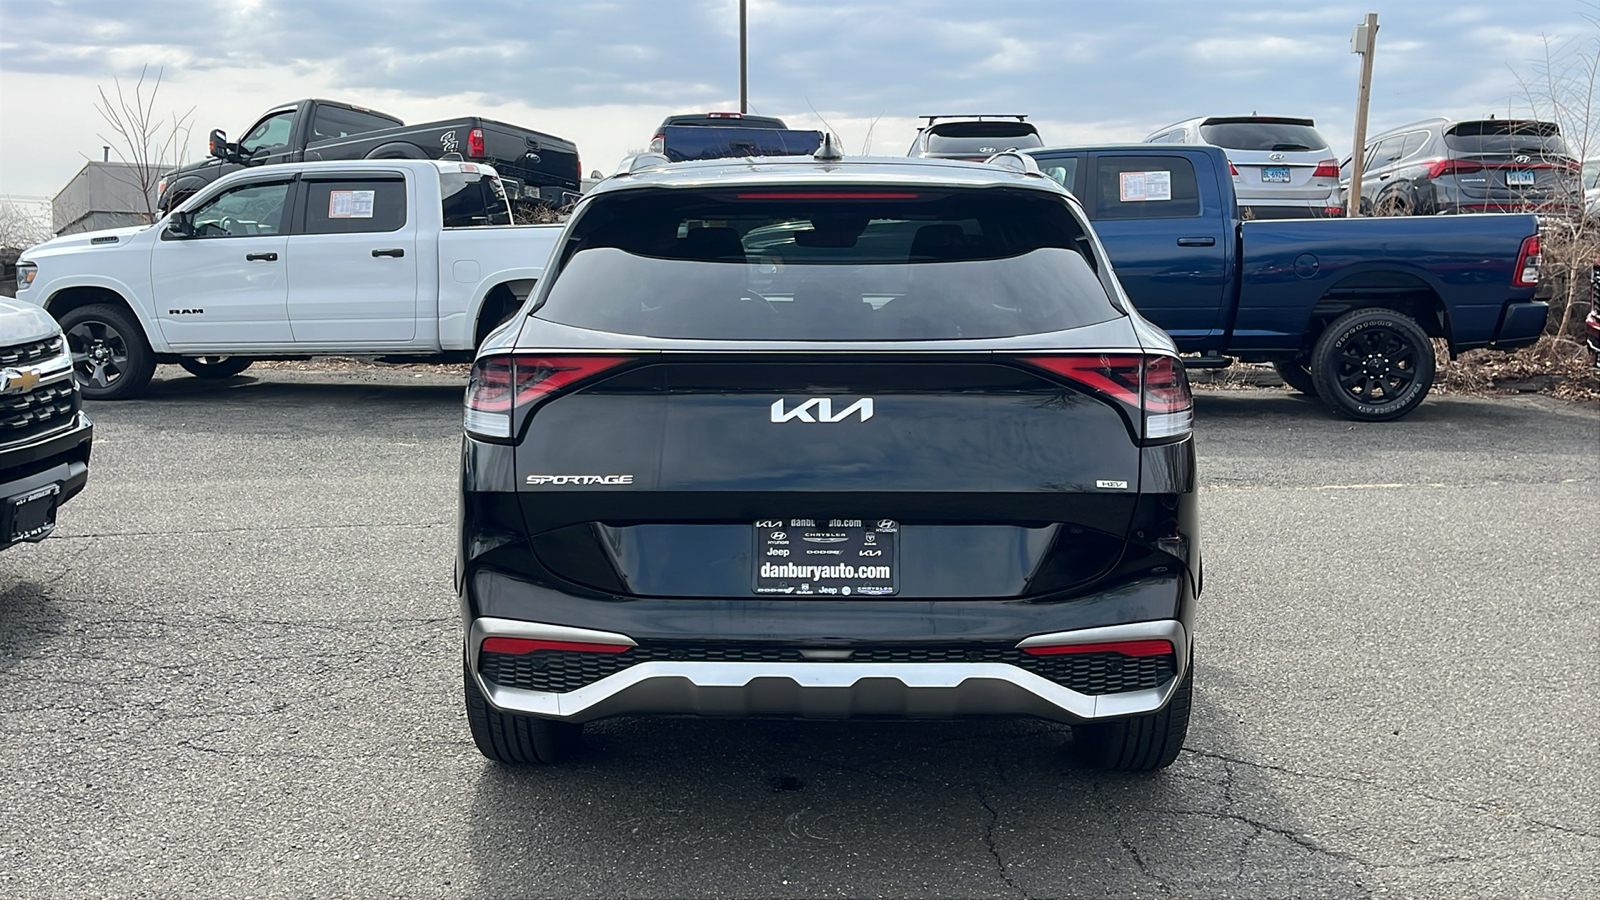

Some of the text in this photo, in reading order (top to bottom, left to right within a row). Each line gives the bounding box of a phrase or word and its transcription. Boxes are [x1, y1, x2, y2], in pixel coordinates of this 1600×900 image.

[771, 398, 874, 423] KIA
[526, 475, 634, 485] SPORTAGE
[766, 547, 790, 557] Jeep
[760, 562, 890, 582] danburyauto.com
[818, 586, 838, 595] Jeep
